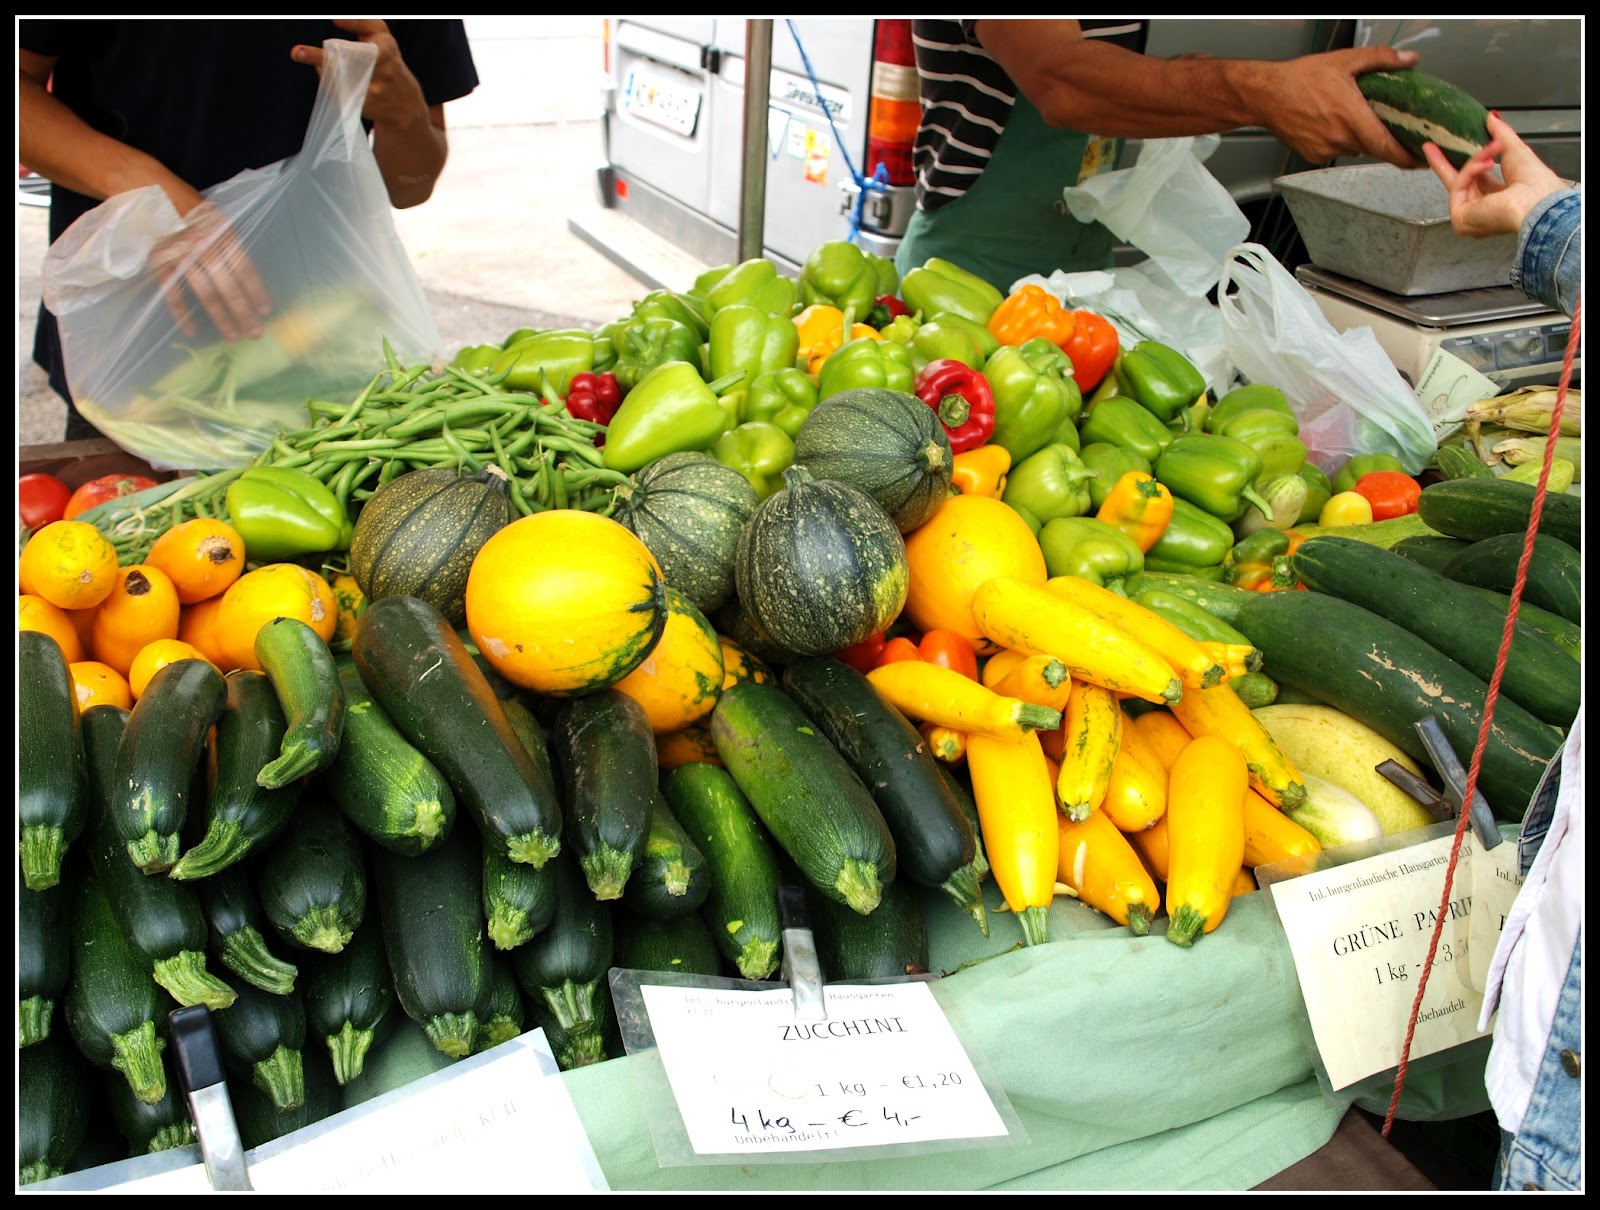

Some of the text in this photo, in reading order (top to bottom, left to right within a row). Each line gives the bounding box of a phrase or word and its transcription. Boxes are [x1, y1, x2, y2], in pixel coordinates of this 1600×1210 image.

[1328, 869, 1398, 893] burgenländische
[1399, 854, 1449, 875] Hausgarten
[1495, 867, 1512, 882] Inl.
[1333, 919, 1404, 957] GRÜNE
[1387, 962, 1408, 981] kg
[1414, 998, 1466, 1025] nbehandelt
[778, 1016, 908, 1041] ZUCCHINI
[815, 1084, 828, 1097] 1
[839, 1081, 867, 1096] kg
[902, 1072, 962, 1089] €1,20
[731, 1107, 750, 1132] 4
[758, 1109, 796, 1133] kg
[837, 1110, 868, 1127] €
